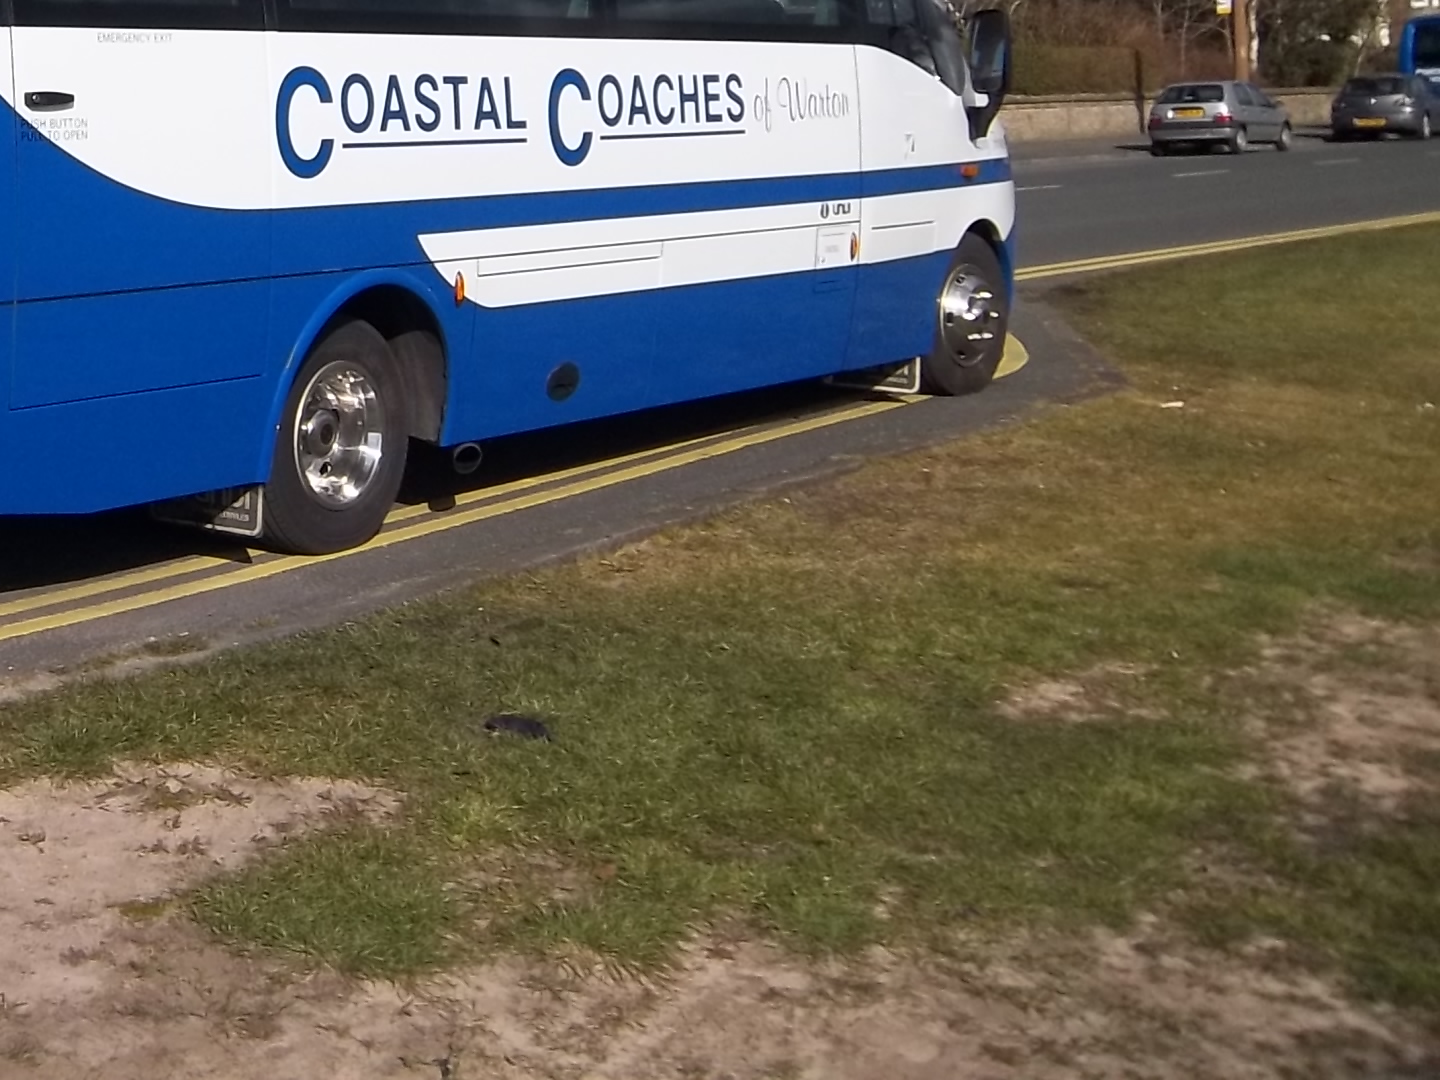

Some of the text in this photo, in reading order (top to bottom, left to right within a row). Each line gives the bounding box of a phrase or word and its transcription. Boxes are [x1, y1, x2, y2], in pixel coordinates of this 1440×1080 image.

[97, 32, 172, 43] EMERGENCY EXIT
[49, 118, 88, 129] BUTTON
[275, 65, 849, 179] COASTAL COACHES of Warton
[47, 130, 60, 141] TO
[63, 130, 88, 140] OPEN
